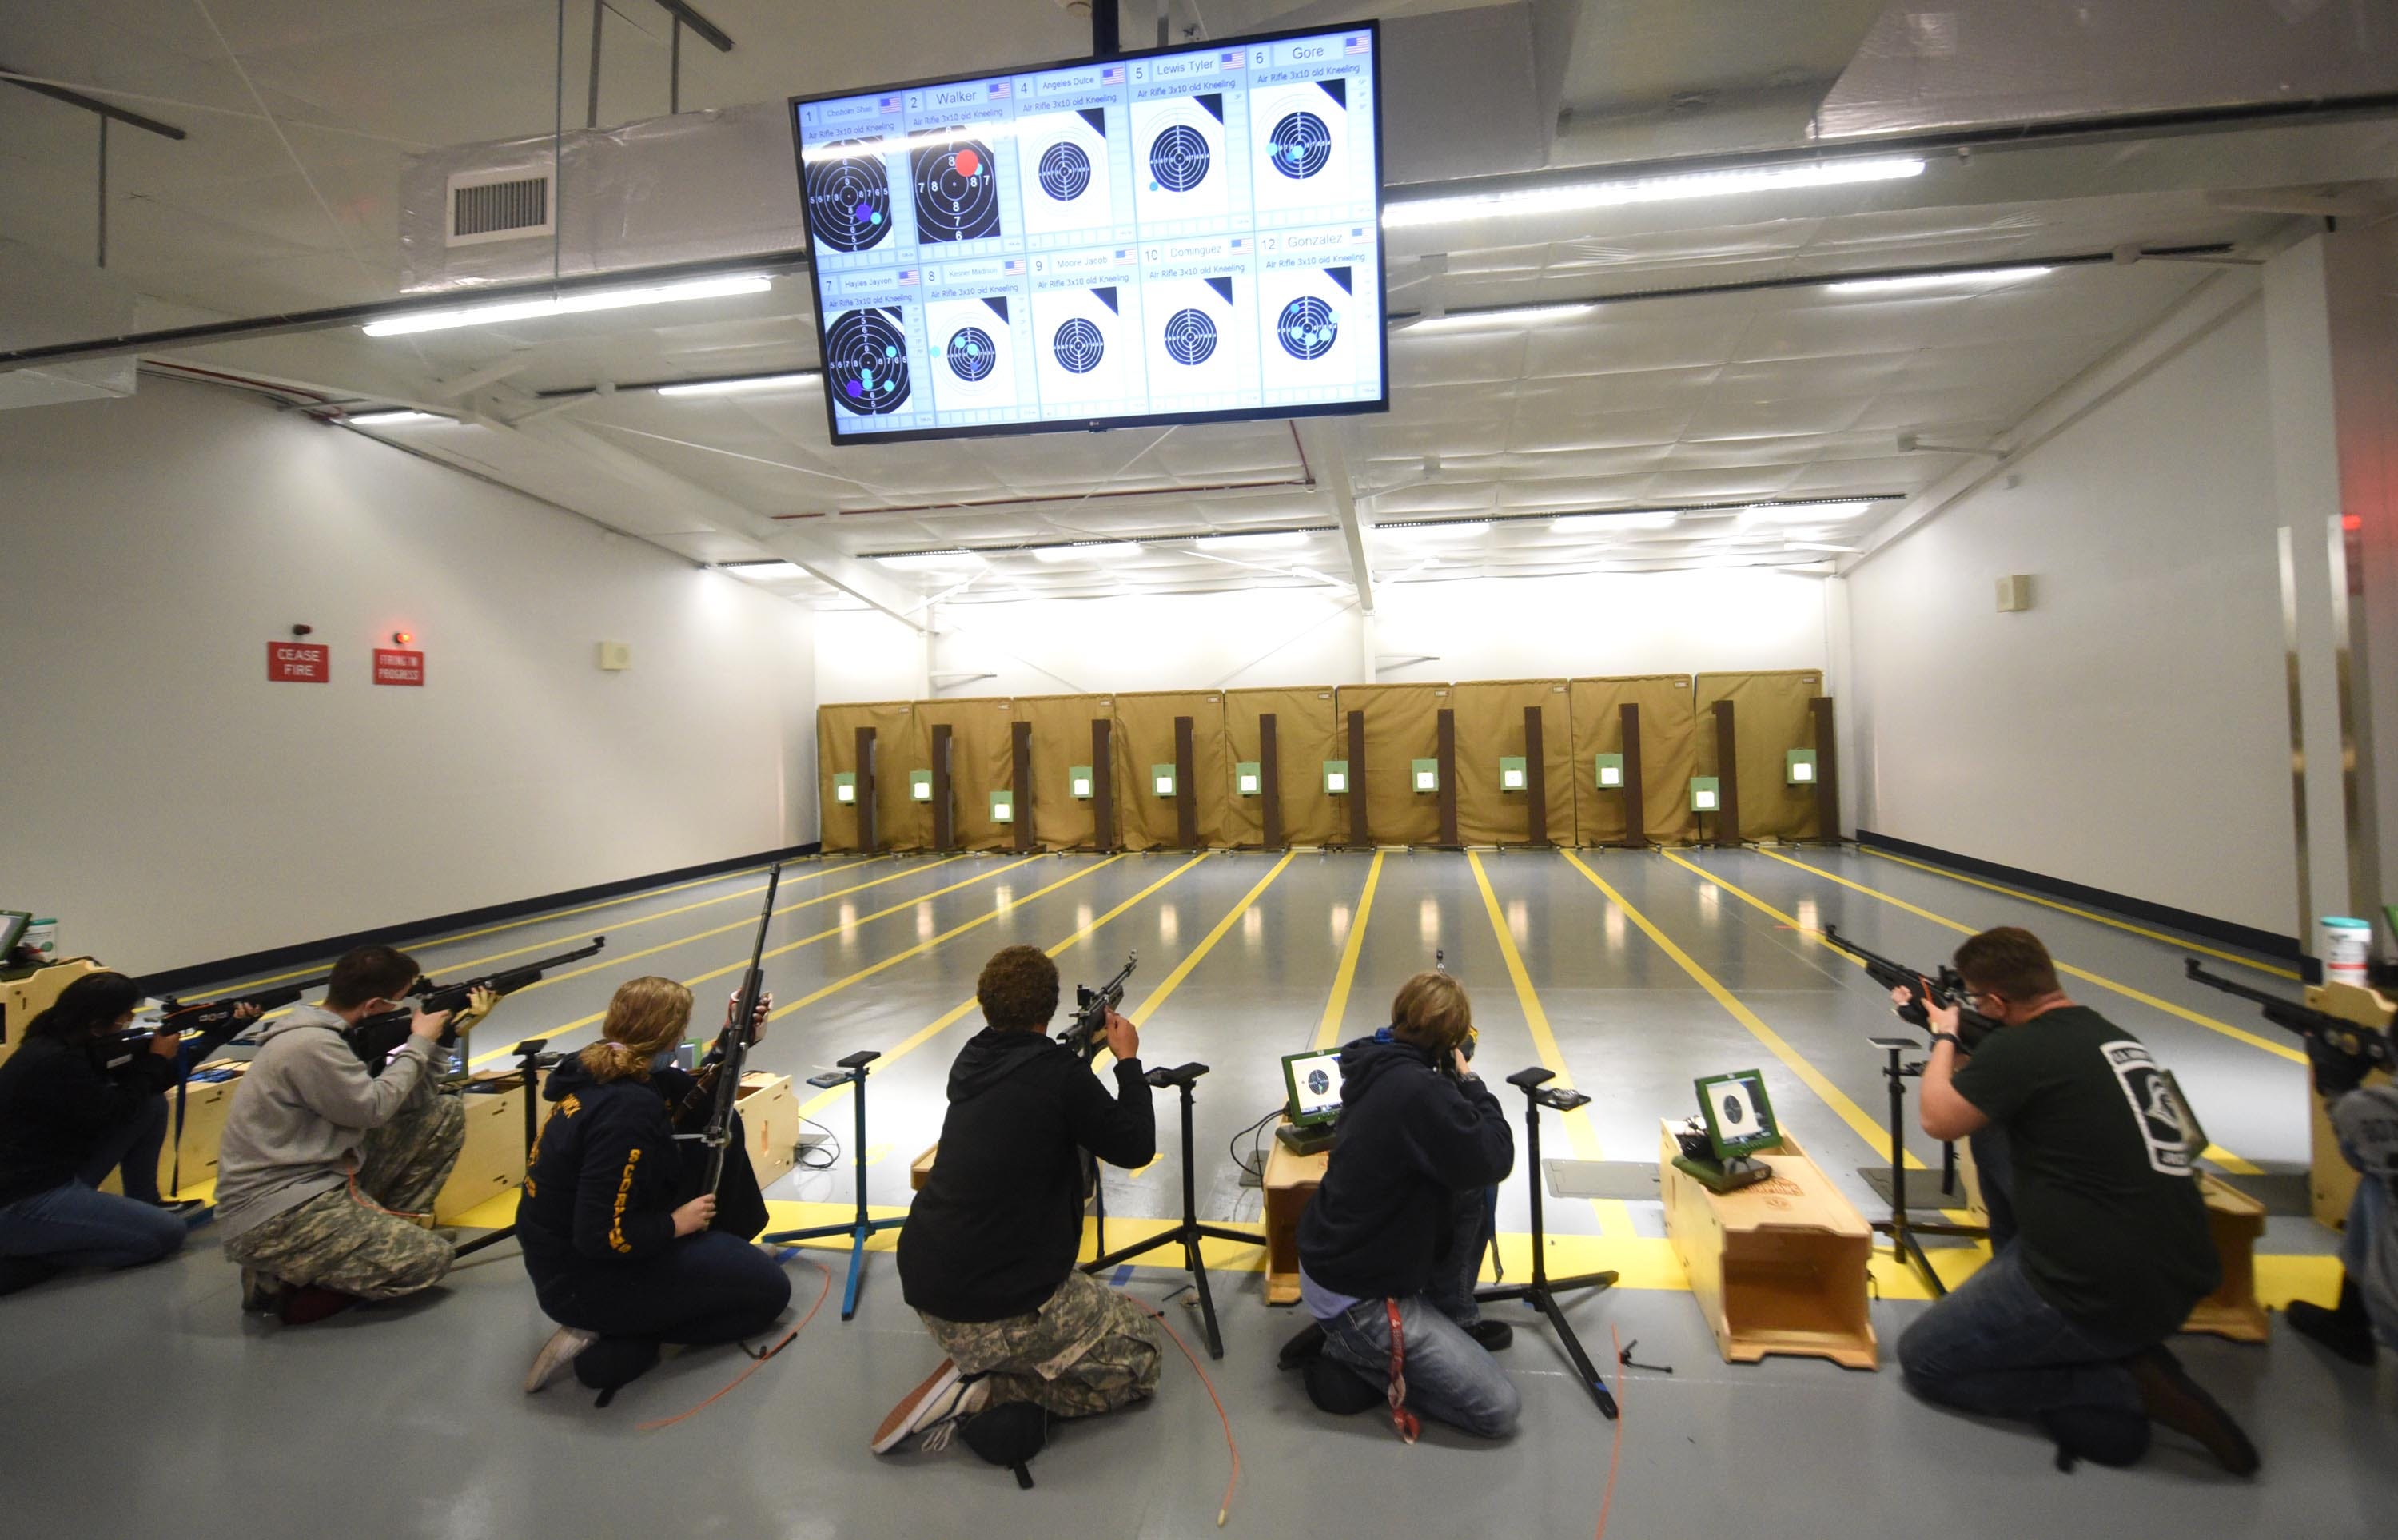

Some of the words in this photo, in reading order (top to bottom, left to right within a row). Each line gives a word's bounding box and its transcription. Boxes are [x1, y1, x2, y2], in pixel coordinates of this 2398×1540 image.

[1256, 52, 1263, 64] 6
[1293, 46, 1324, 58] Gore
[1136, 67, 1142, 79] 5
[1157, 64, 1185, 75] Lewis
[1188, 60, 1213, 73] Tyler
[1271, 72, 1287, 81] Rifle
[1290, 70, 1309, 79] 3x10
[1312, 68, 1323, 77] old
[1327, 65, 1360, 74] Kneeling
[1021, 82, 1027, 94] 4
[1043, 80, 1071, 90] Angeles
[1169, 85, 1187, 94] 3x10
[1204, 79, 1235, 89] Kneeling
[910, 97, 917, 108] 2
[936, 91, 977, 105] Walker
[1086, 94, 1116, 103] Kneeling
[807, 111, 811, 121] 1
[974, 109, 1002, 117] Kneeling
[866, 122, 894, 131] Kneeling
[949, 157, 955, 166] 8
[918, 183, 925, 193] 7
[931, 181, 938, 192] 8
[970, 177, 977, 187] 8
[983, 175, 990, 185] 7
[953, 201, 959, 212] 8
[954, 217, 961, 226] 7
[955, 230, 962, 241] 6
[1261, 238, 1275, 249] 12
[1288, 233, 1342, 247] Gonzalez
[1145, 250, 1157, 262] 10
[1171, 245, 1221, 257] Dominguez
[1036, 261, 1042, 271] 9
[1085, 256, 1107, 265] Jacob
[1213, 264, 1245, 273] Kneeling
[929, 271, 934, 281] 8
[1099, 274, 1129, 283] Kneeling
[826, 281, 831, 291] 7
[277, 648, 321, 662] CEASE
[284, 664, 315, 677] FIRE
